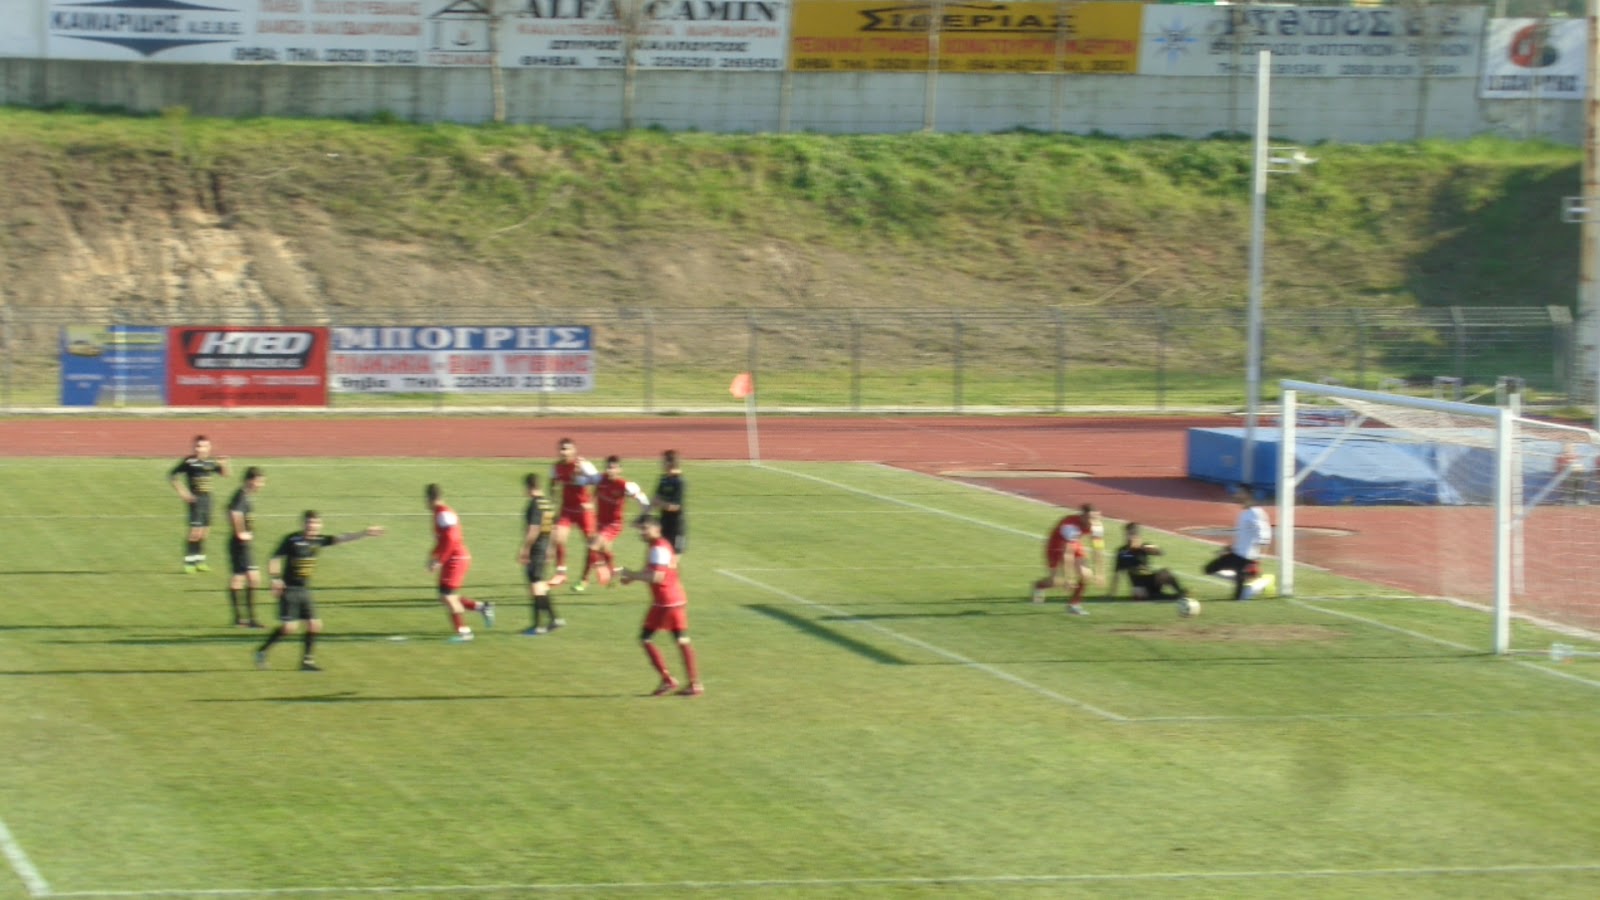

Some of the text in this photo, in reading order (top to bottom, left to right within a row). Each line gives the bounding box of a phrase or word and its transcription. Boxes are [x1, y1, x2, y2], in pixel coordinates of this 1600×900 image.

[645, 0, 781, 21] CAMIN
[53, 11, 181, 33] ΚΑΜΑΡΙΔΗΣ
[338, 328, 585, 349] ΜΠΟΓΡΗΣ
